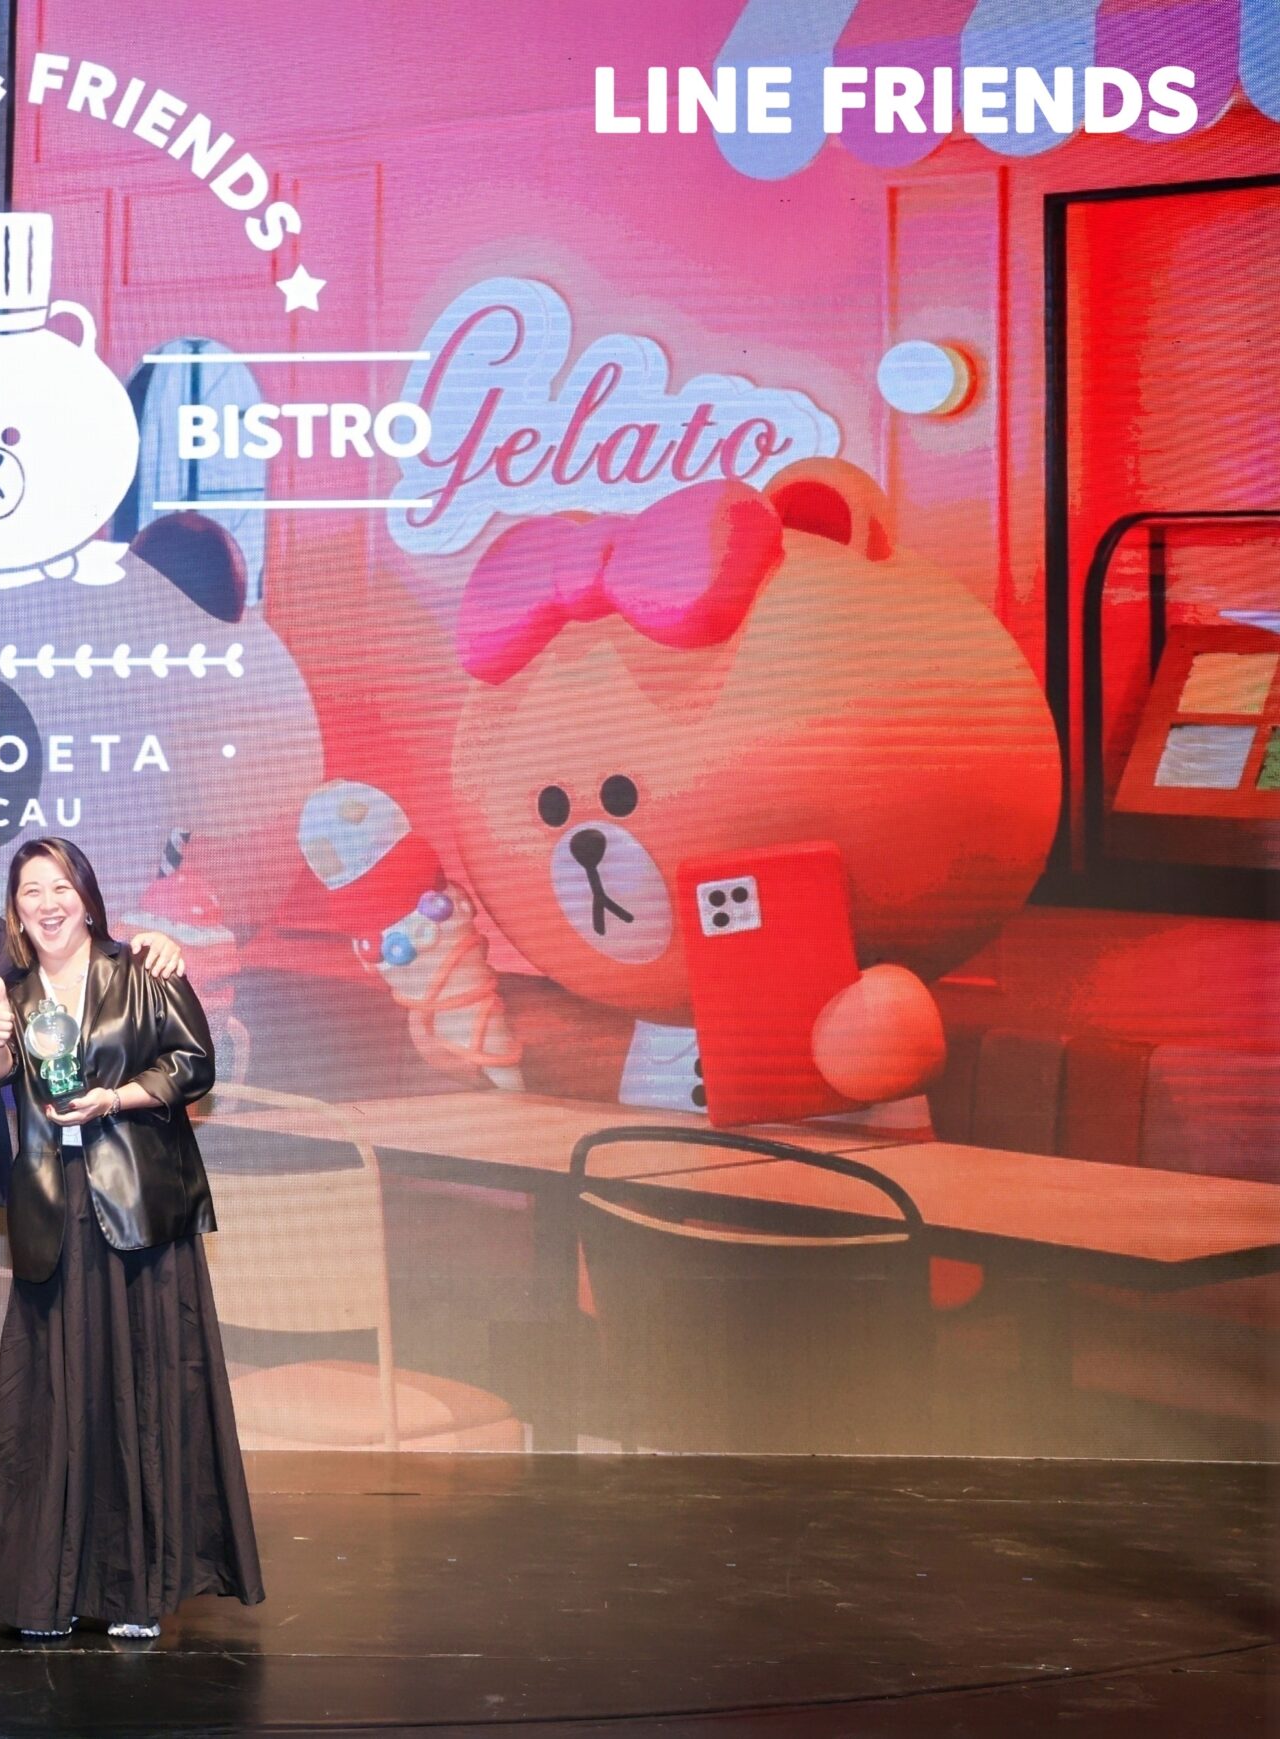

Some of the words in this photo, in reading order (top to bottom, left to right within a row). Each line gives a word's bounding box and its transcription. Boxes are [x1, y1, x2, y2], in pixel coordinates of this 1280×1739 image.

[28, 52, 302, 252] FRIENDS
[594, 65, 793, 135] LINE
[822, 65, 1200, 136] FRIENDS
[176, 401, 433, 461] BISTRO
[406, 303, 793, 529] Gelato
